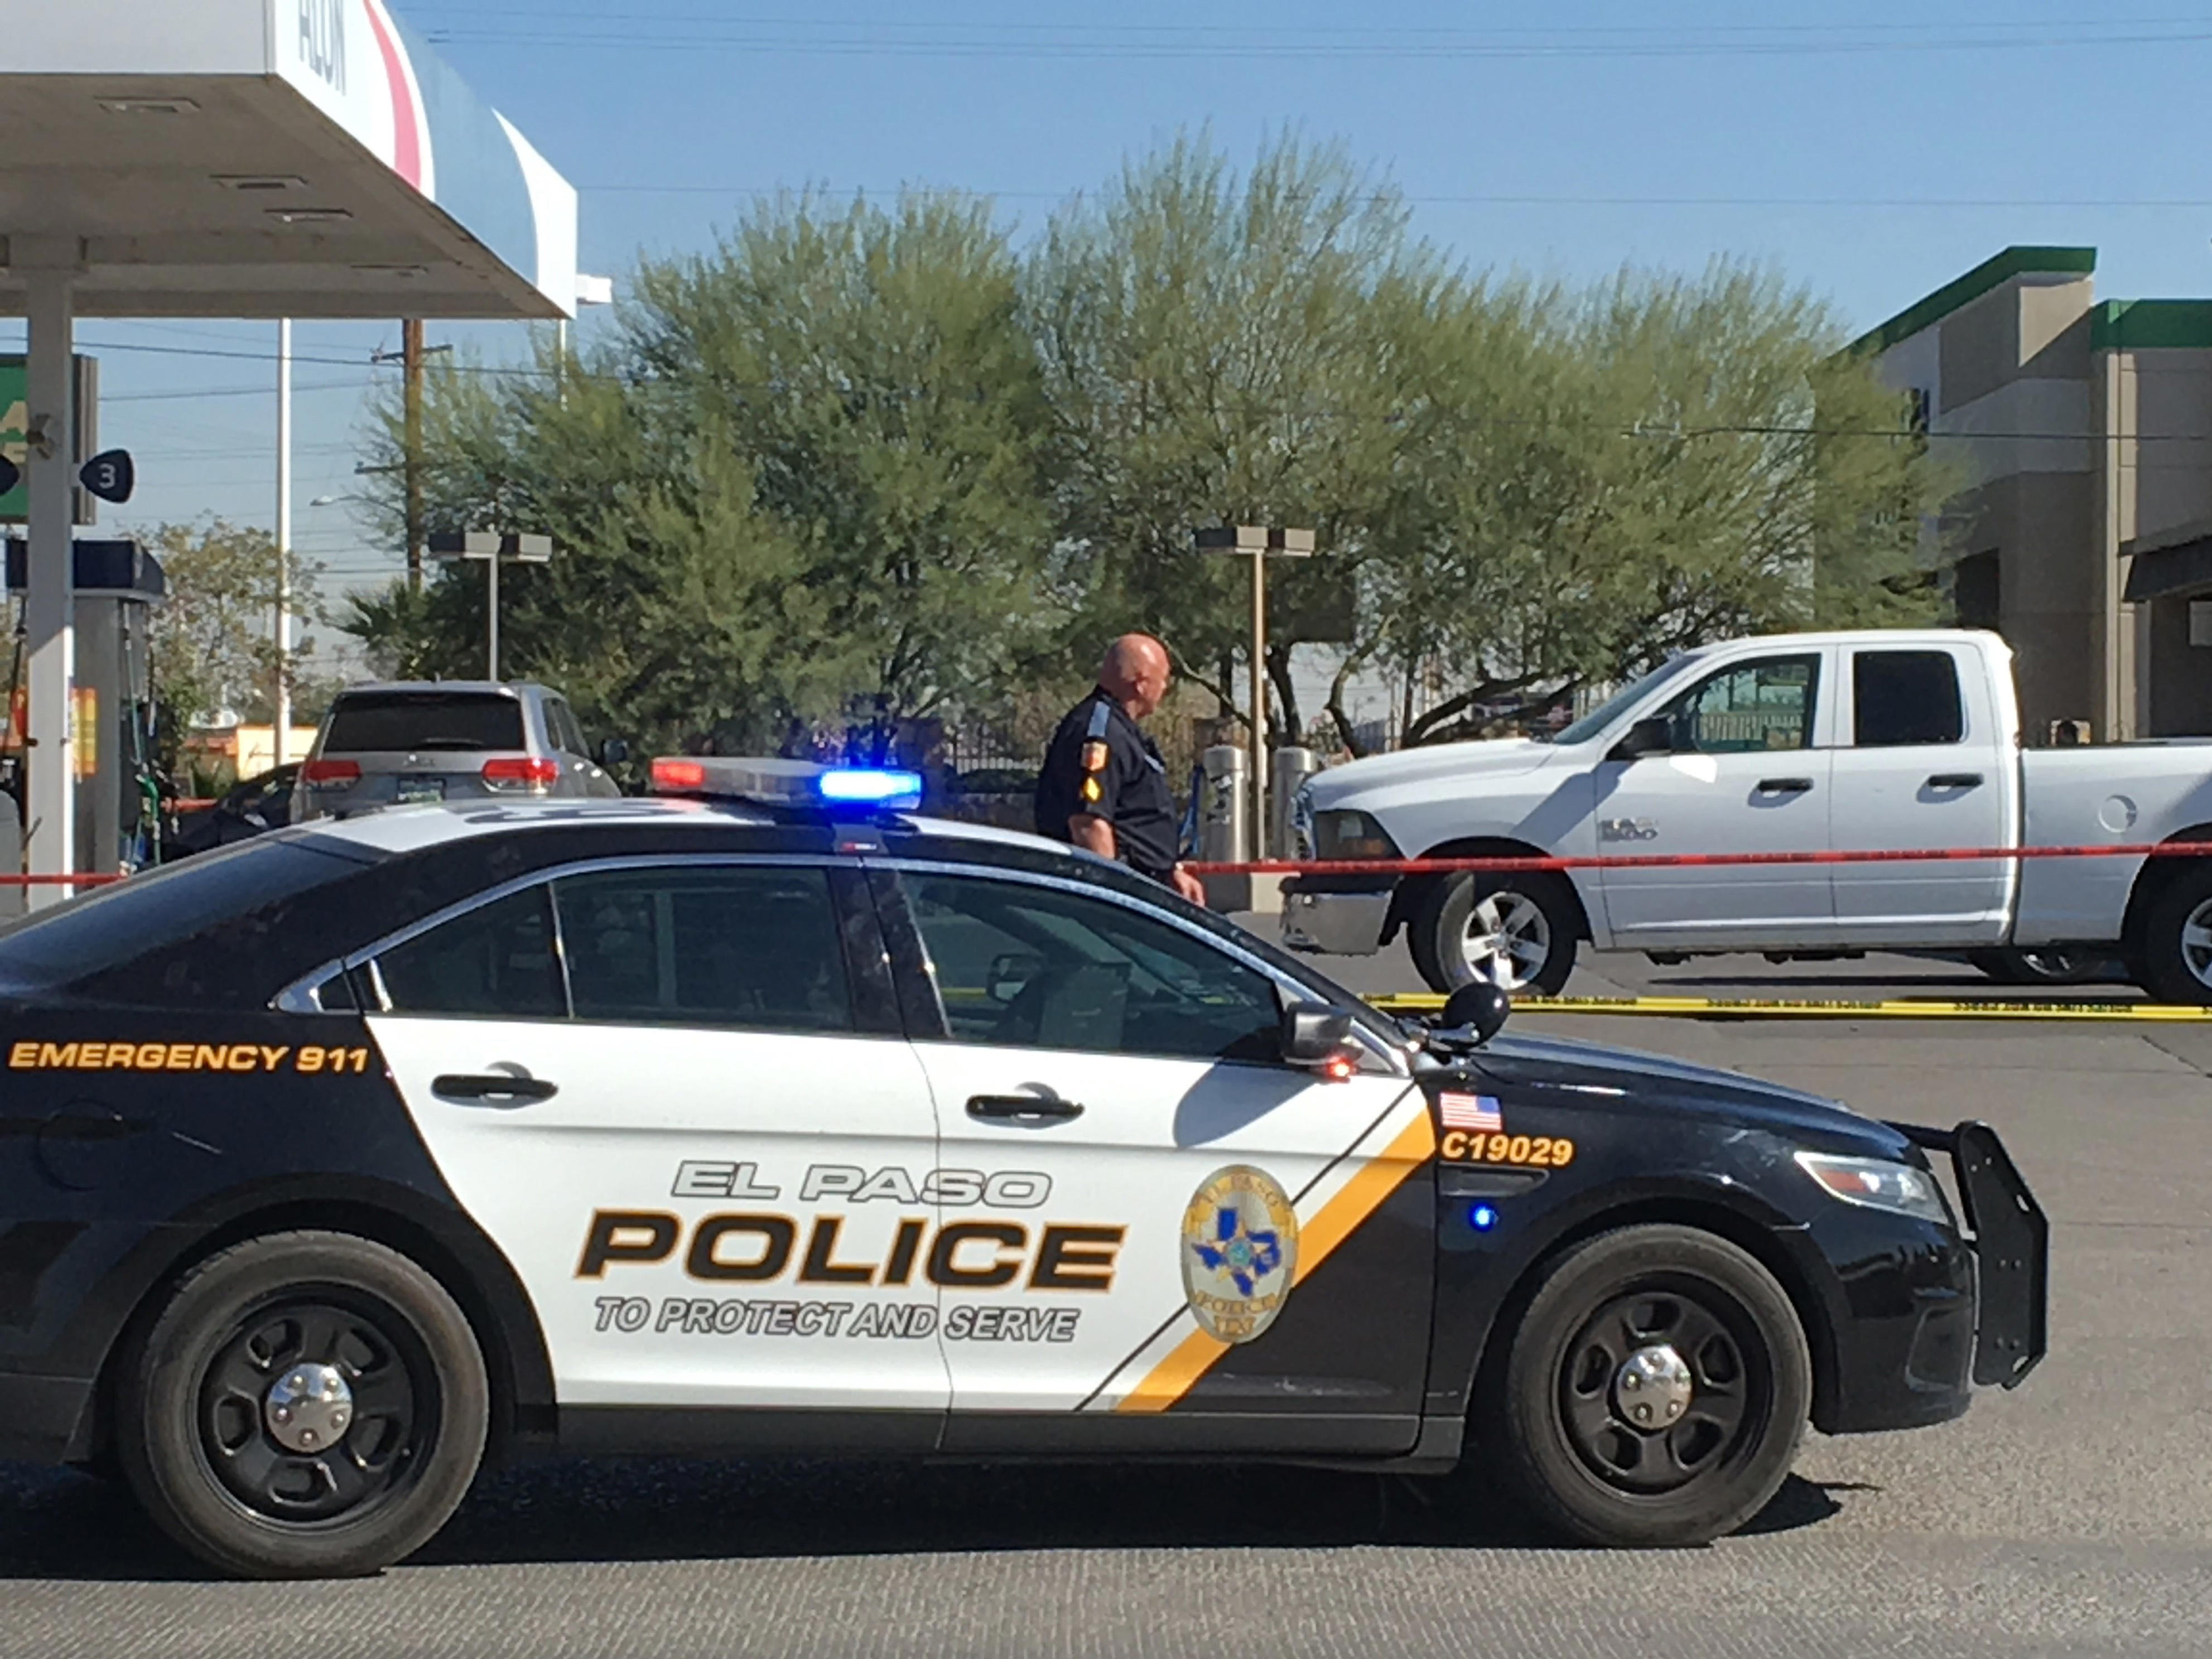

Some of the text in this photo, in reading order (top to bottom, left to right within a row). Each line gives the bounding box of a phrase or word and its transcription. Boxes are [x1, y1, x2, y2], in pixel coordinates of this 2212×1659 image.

[99, 463, 115, 489] 3
[9, 1043, 368, 1072] EMERGENCY 911
[1442, 1131, 1573, 1165] C19029
[671, 1160, 1052, 1208] EL PASO
[574, 1209, 1128, 1293] POLICE
[595, 1297, 1081, 1342] TO PROTECT AND SERVE
